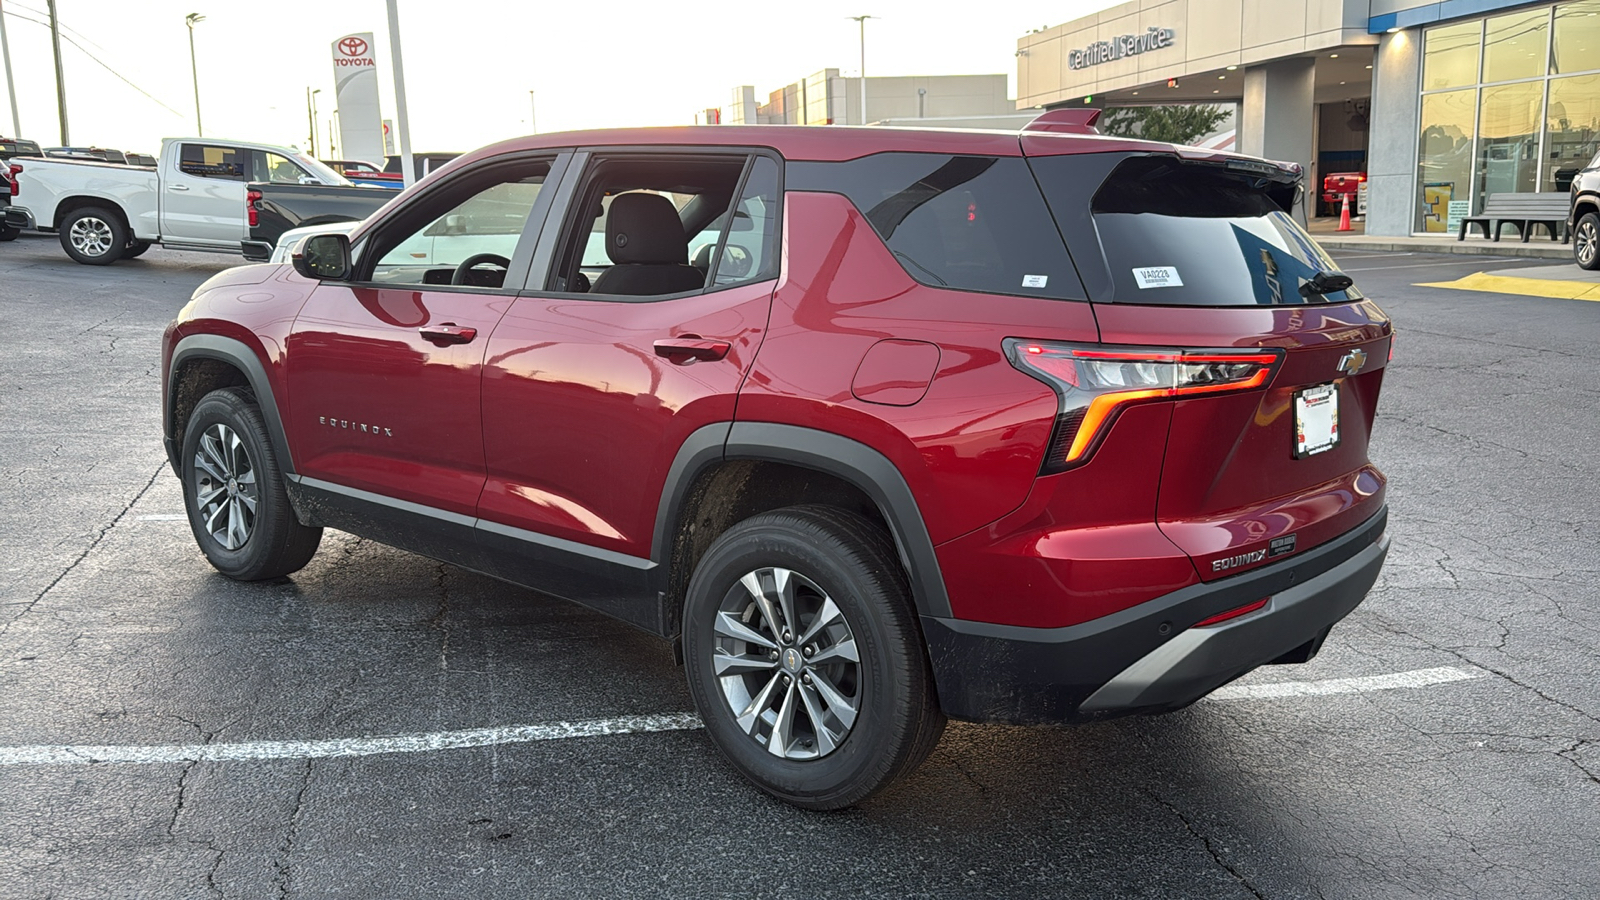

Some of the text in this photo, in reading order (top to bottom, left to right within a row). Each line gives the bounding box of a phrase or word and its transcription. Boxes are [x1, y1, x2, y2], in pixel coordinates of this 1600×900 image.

[1068, 28, 1171, 70] Certified Service
[334, 58, 375, 67] TOYOTA
[1140, 269, 1170, 279] VA0228
[319, 416, 392, 437] EQUINOX
[1212, 548, 1267, 572] EQUINOX
